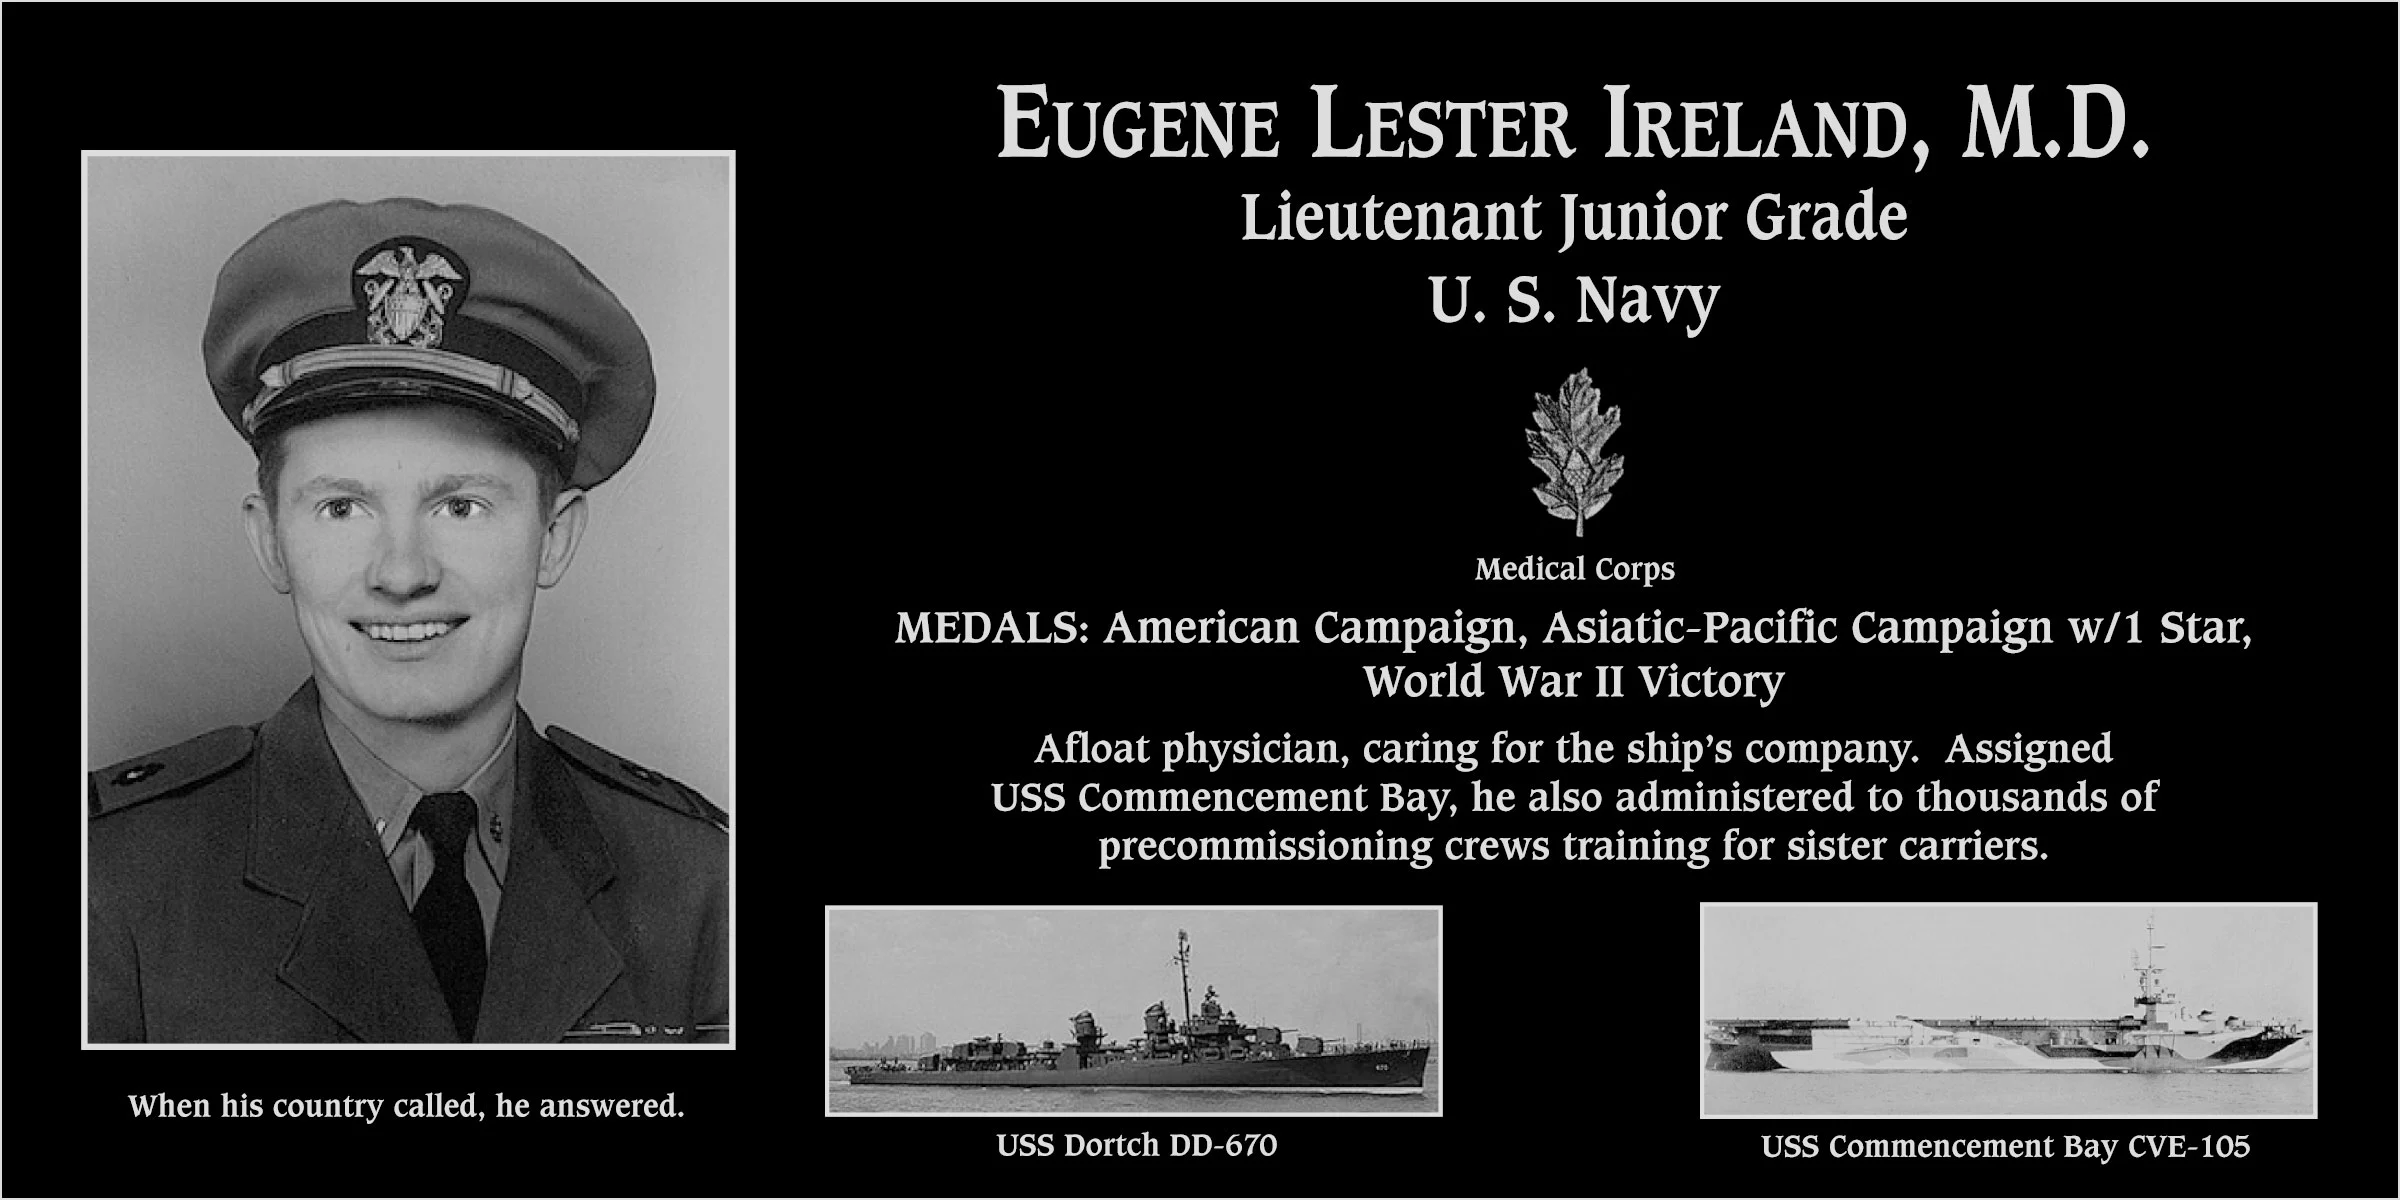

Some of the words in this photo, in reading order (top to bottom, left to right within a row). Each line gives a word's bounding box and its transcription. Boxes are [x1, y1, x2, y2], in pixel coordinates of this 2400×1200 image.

[1961, 83, 2150, 159] M.D.
[1240, 189, 1543, 241] Lieutenant
[1557, 188, 1730, 254] Junior
[1746, 186, 1908, 241] Grade
[1427, 275, 1486, 324] U.
[1507, 275, 1556, 324] S.
[1575, 275, 1722, 339] Navy
[1474, 554, 1587, 581] Medical
[1595, 557, 1676, 588] Corps
[894, 610, 1089, 644] MEDALS:
[1102, 608, 1301, 644] American
[1314, 608, 1528, 655] Campaign,
[1541, 606, 1838, 644] Asiatic-Pacific
[1851, 608, 2055, 655] Campaign
[2067, 610, 2143, 644] w/1
[2160, 610, 2252, 650] Star,
[1361, 661, 1486, 698] World
[1497, 664, 1583, 698] War
[1594, 665, 1625, 698] II
[1637, 662, 1786, 709] Victory
[1033, 729, 1151, 764] Afloat
[1161, 730, 1350, 773] physician,
[1363, 731, 1480, 773] caring
[1490, 730, 1545, 764] for
[1555, 730, 1615, 764] the
[1627, 730, 1733, 773] ship’s
[1745, 739, 1919, 773] company.
[1944, 730, 2115, 773] Assigned
[990, 782, 1066, 813] USS
[1078, 782, 1369, 813] Commencement
[1379, 782, 1458, 822] Bay,
[1470, 779, 1516, 813] he
[1528, 779, 1603, 813] also
[1615, 779, 1856, 813] administered
[1866, 783, 1904, 813] to
[1915, 779, 2108, 813] thousands
[2120, 778, 2161, 813] of
[1098, 828, 1435, 870] precommissioning
[1444, 836, 1550, 861] crews
[1562, 828, 1712, 870] training
[1722, 827, 1776, 861] for
[1787, 828, 1889, 861] sister
[1899, 829, 2049, 861] carriers.
[127, 1091, 212, 1118] When
[220, 1091, 264, 1118] his
[272, 1095, 385, 1125] country
[393, 1091, 485, 1122] called,
[494, 1091, 530, 1118] he
[539, 1091, 685, 1118] answered.
[995, 1133, 1055, 1157] USS
[1063, 1130, 1161, 1157] Dortch
[1169, 1133, 1278, 1157] DD-670
[1760, 1134, 1820, 1159] USS
[1829, 1134, 2055, 1159] Commencement
[2063, 1134, 2120, 1166] Bay
[2128, 1134, 2251, 1159] CVE-105
